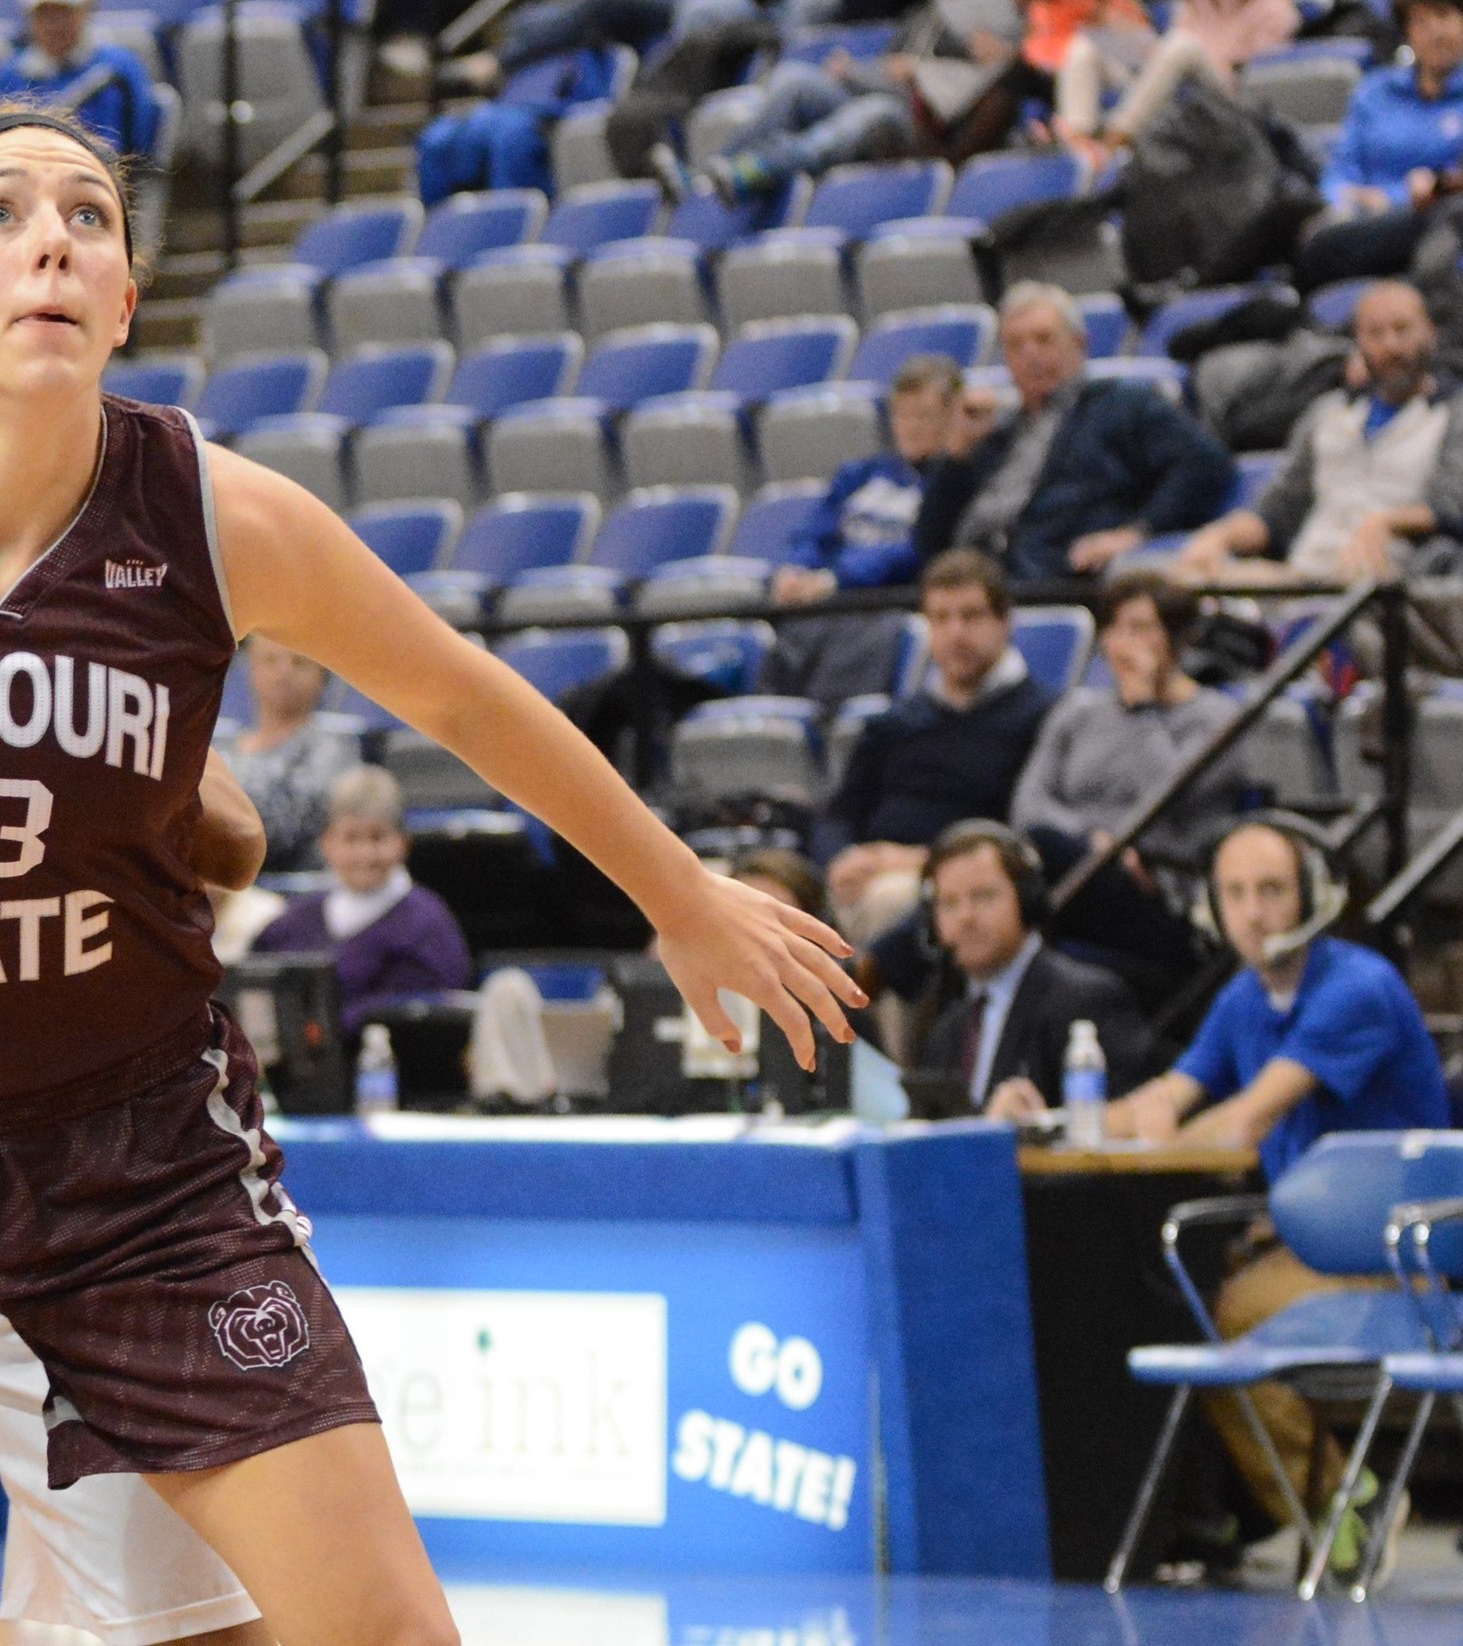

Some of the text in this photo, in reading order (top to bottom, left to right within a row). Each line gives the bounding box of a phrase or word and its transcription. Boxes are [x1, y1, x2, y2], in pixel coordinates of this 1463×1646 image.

[105, 559, 168, 589] VALLEY
[475, 1322, 635, 1460] ink
[728, 1320, 824, 1412] GO
[672, 1408, 858, 1532] STATE!
